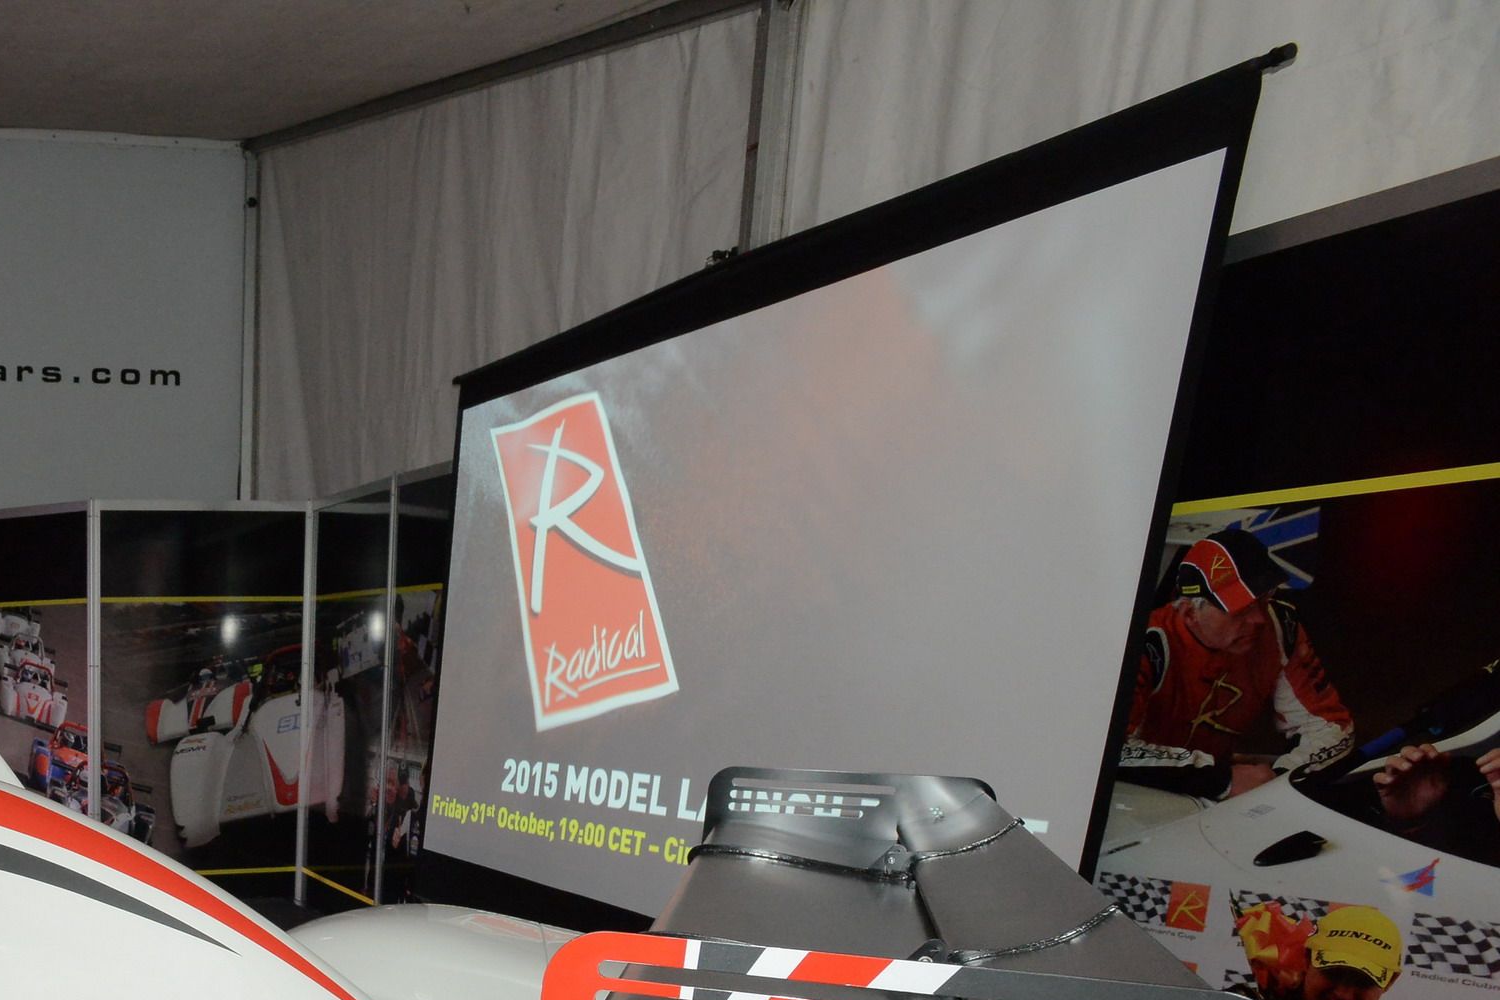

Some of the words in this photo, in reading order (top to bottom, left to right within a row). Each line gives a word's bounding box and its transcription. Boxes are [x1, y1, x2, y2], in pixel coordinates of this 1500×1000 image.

[543, 609, 646, 708] Radical
[501, 758, 560, 798] 2015
[564, 765, 668, 817] MODEL
[431, 795, 470, 825] Friday
[497, 807, 555, 842] October,
[559, 817, 605, 847] 19:00
[608, 826, 646, 857] CET
[1325, 928, 1393, 952] DUNLOP
[1411, 970, 1459, 984] Radical
